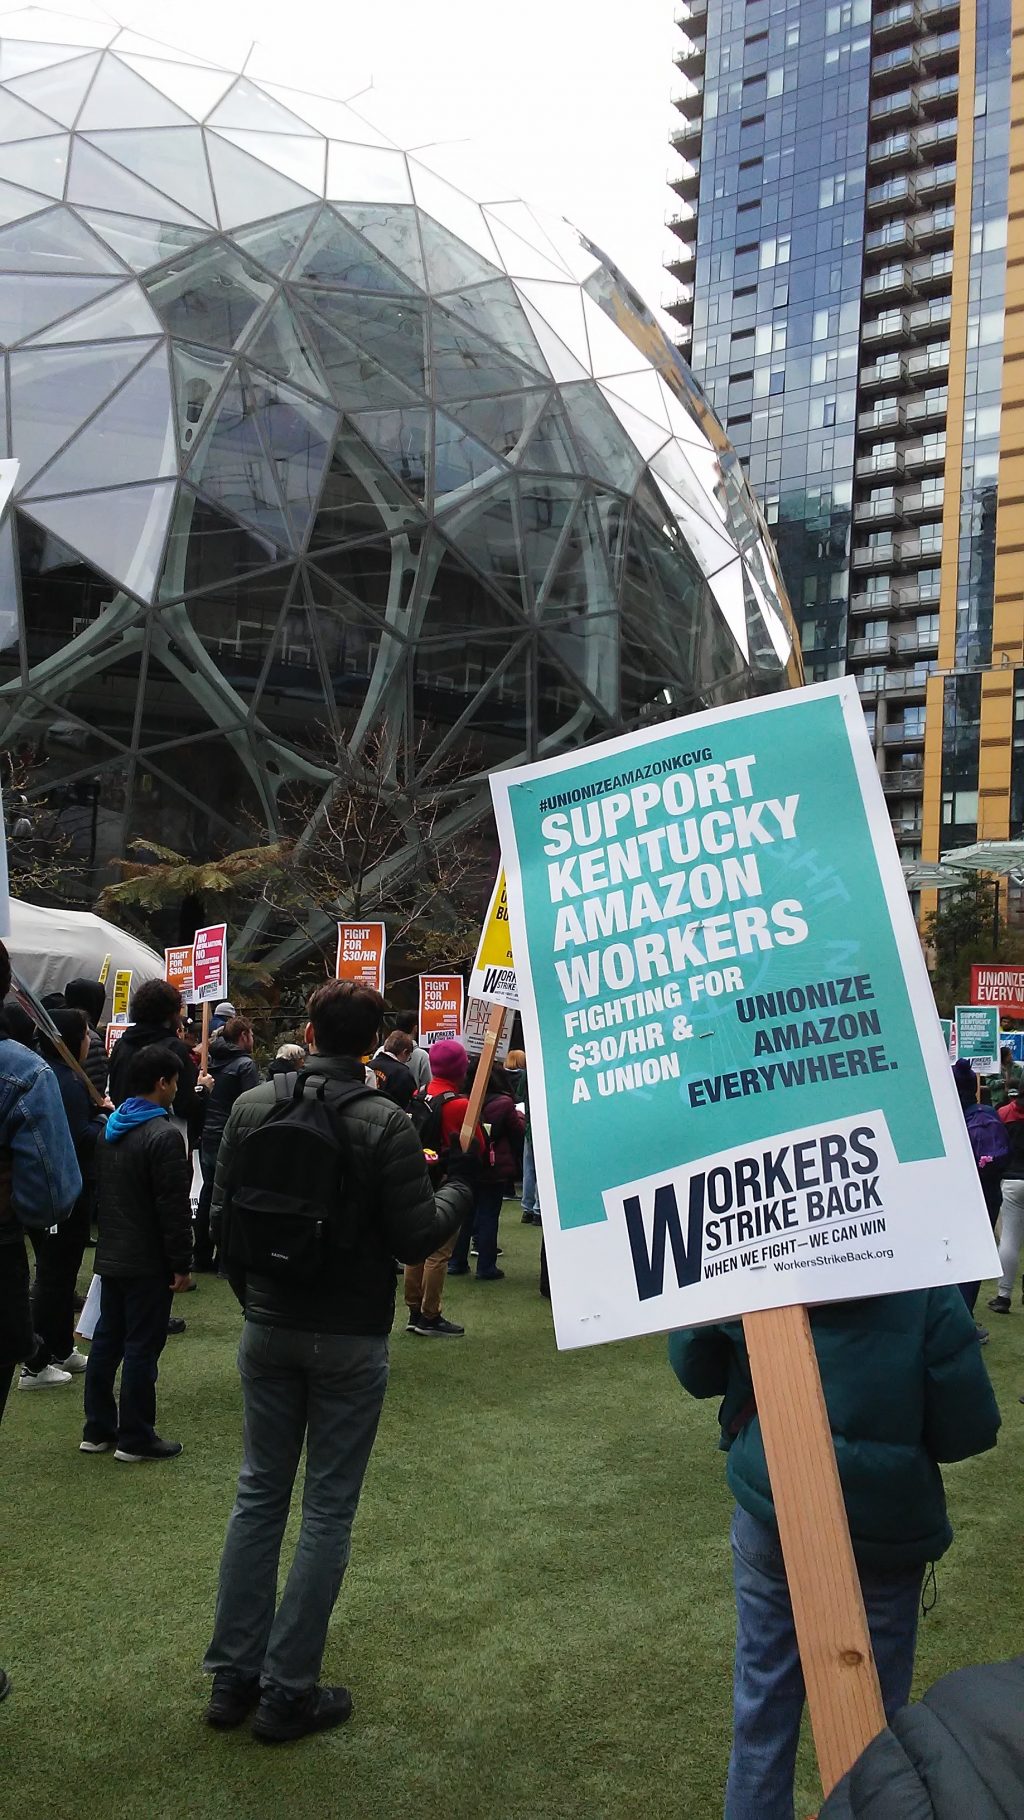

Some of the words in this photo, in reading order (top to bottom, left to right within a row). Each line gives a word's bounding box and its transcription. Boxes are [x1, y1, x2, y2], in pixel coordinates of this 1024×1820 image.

[539, 748, 713, 812] #UNIONIZEAMAZONKCVG
[541, 754, 757, 857] SUPPORT
[547, 794, 800, 903] KENTUCKY
[553, 853, 763, 952] AMAZON
[169, 951, 189, 960] FIGHT
[195, 950, 206, 960] NO
[198, 932, 207, 943] NO
[342, 950, 377, 961] $30/HR
[343, 940, 362, 950] FOR
[344, 929, 371, 940] FIGHT
[554, 899, 809, 1004] WORKERS
[169, 959, 183, 968] FOR
[424, 981, 450, 991] FIGHT
[497, 981, 517, 991] STRIKE
[424, 991, 442, 1000] FOR
[424, 1000, 457, 1010] $30/HR
[564, 982, 682, 1037] FIGHTING
[687, 966, 745, 1002] FOR
[735, 974, 876, 1023] UNIONIZE
[977, 986, 1024, 1002] EVERYW
[567, 1021, 665, 1072] $30/HR
[672, 1015, 695, 1041] &
[753, 1009, 883, 1057] AMAZON
[572, 1077, 592, 1104] A
[597, 1052, 681, 1097] UNION
[687, 1044, 899, 1108] EVERYWHERE.
[622, 1126, 880, 1302] WORKERS
[705, 1196, 799, 1252] STRIKE
[806, 1176, 884, 1223] BACK
[704, 1255, 739, 1280] WHEN
[741, 1250, 760, 1267] WE
[832, 1223, 858, 1244] CAN
[861, 1217, 887, 1236] WIN
[773, 1249, 894, 1273] WorkersStrikeBack.org
